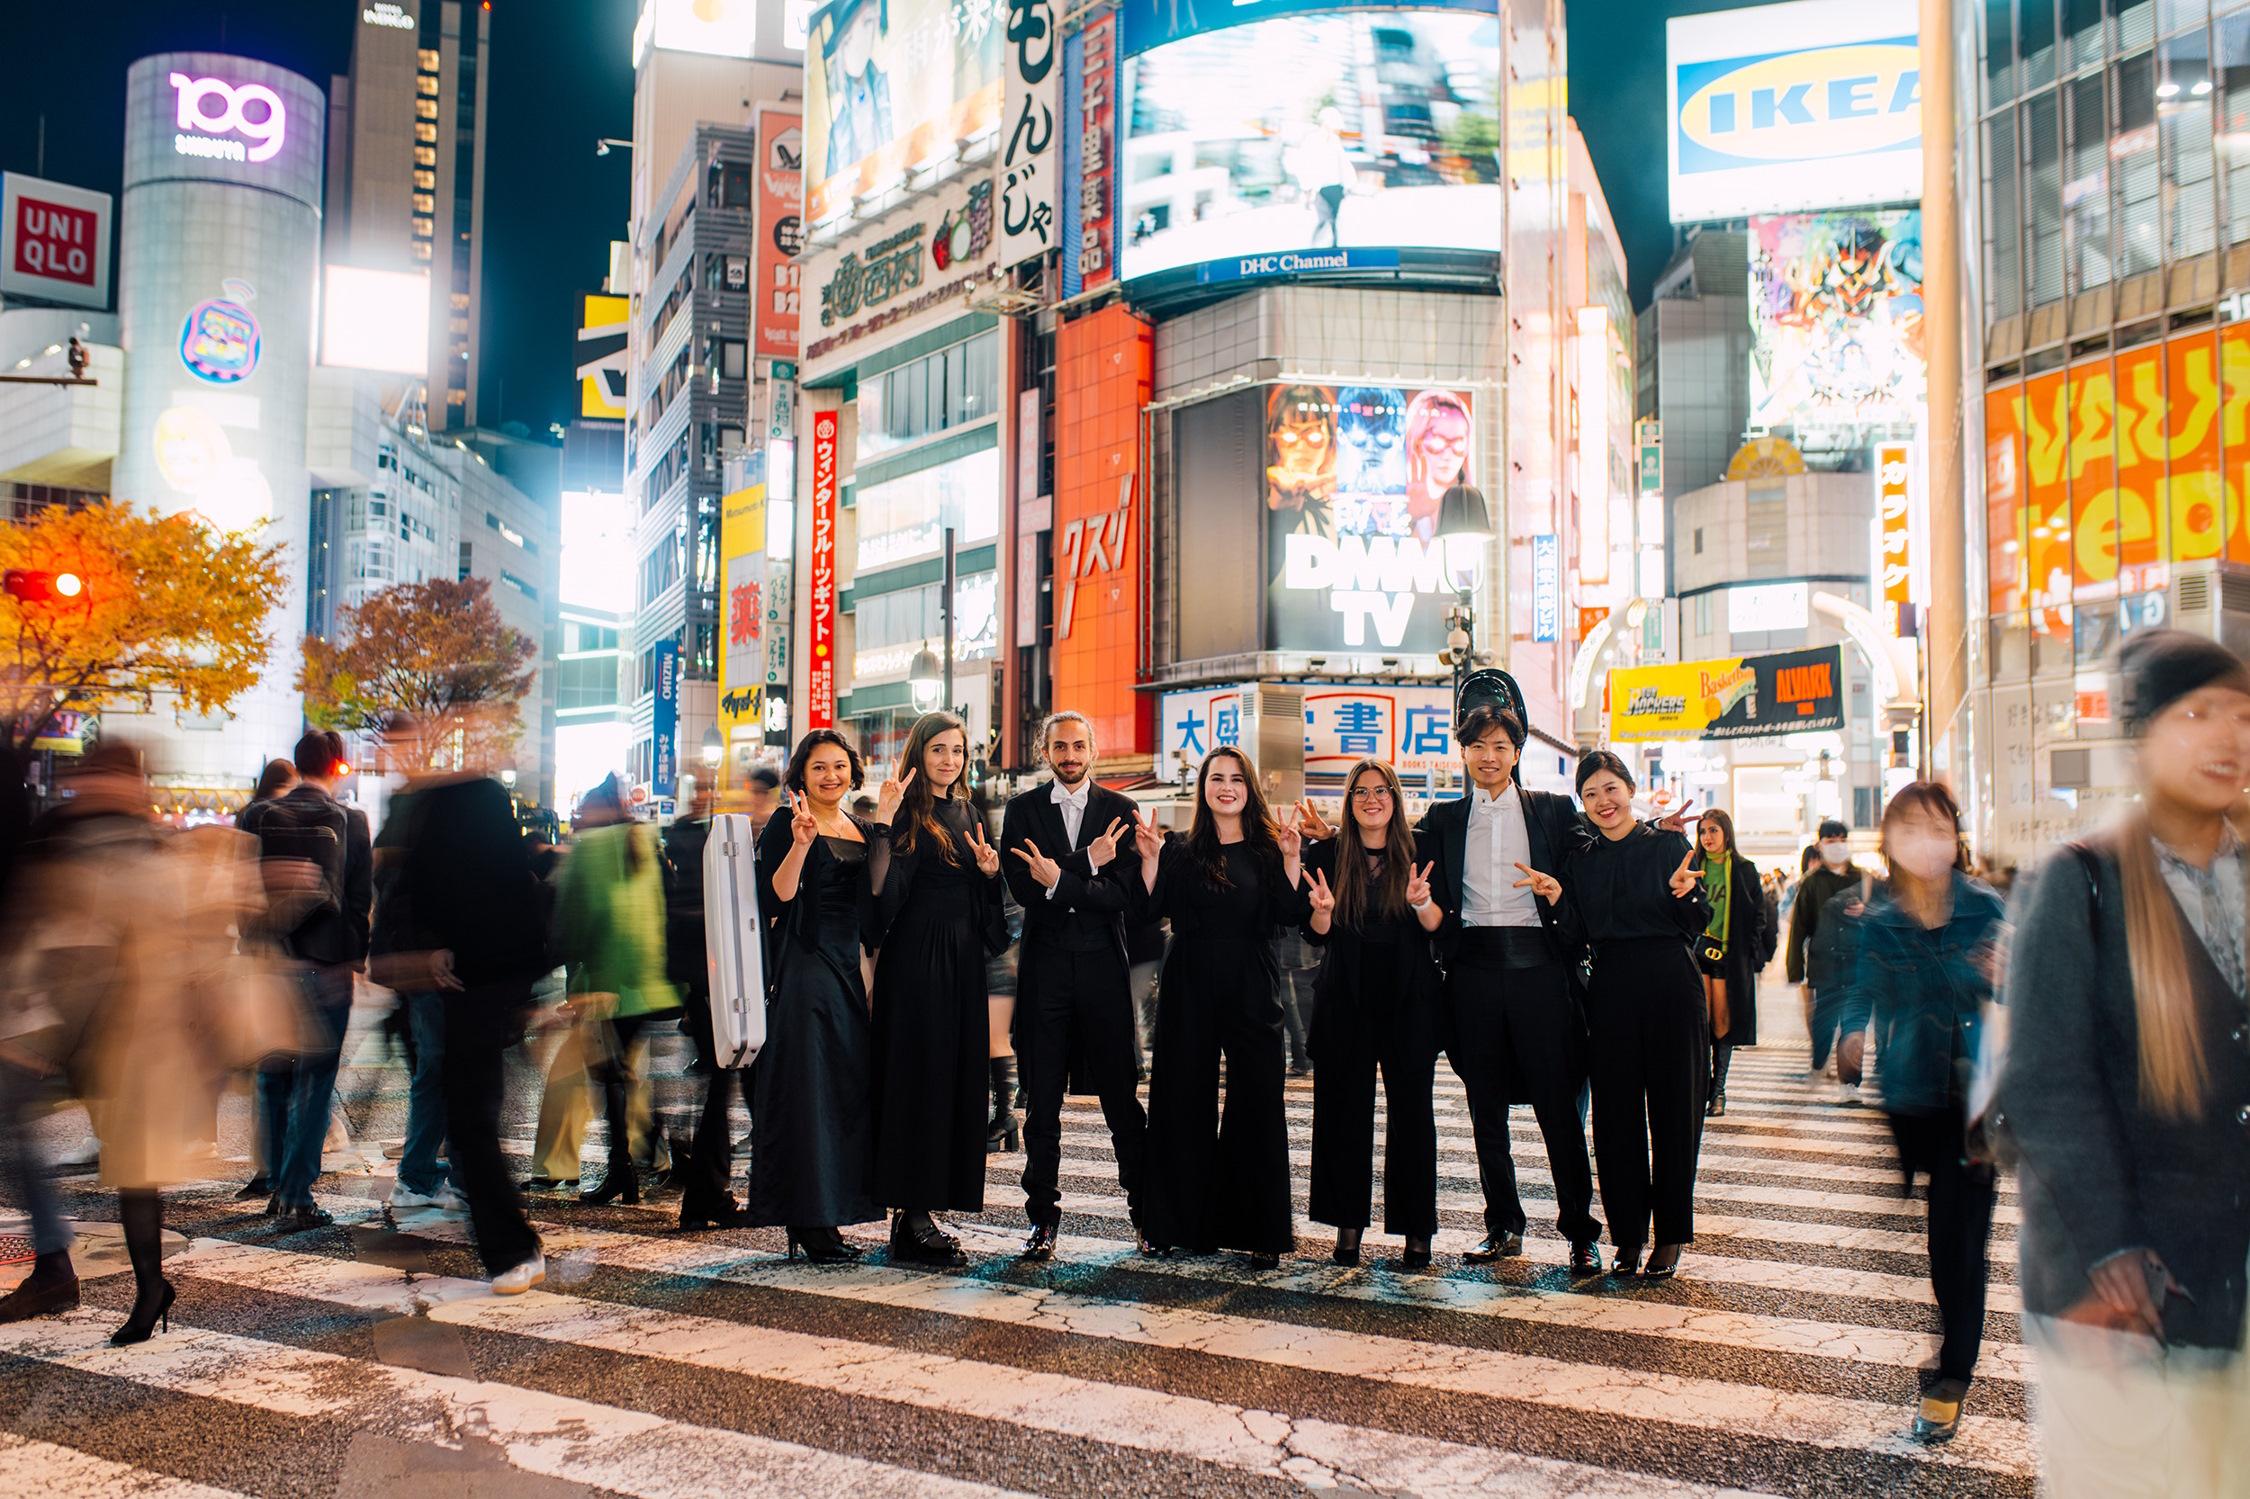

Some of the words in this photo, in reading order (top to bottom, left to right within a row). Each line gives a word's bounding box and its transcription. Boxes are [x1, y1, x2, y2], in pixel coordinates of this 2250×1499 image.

[169, 72, 286, 162] 109
[1002, 0, 1054, 244] もんじゃ
[25, 206, 84, 242] UNI
[23, 237, 88, 276] QLO
[1240, 256, 1278, 275] DHC
[1279, 250, 1348, 271] Channel
[814, 441, 833, 641] ウィンターフルーツギフト
[1881, 460, 1910, 589] カラオケ
[731, 579, 762, 645] 薬
[1331, 590, 1416, 647] TV
[662, 652, 674, 700] MIZUHO
[1776, 662, 1833, 703] ALVARK
[1402, 760, 1426, 769] BOOKS
